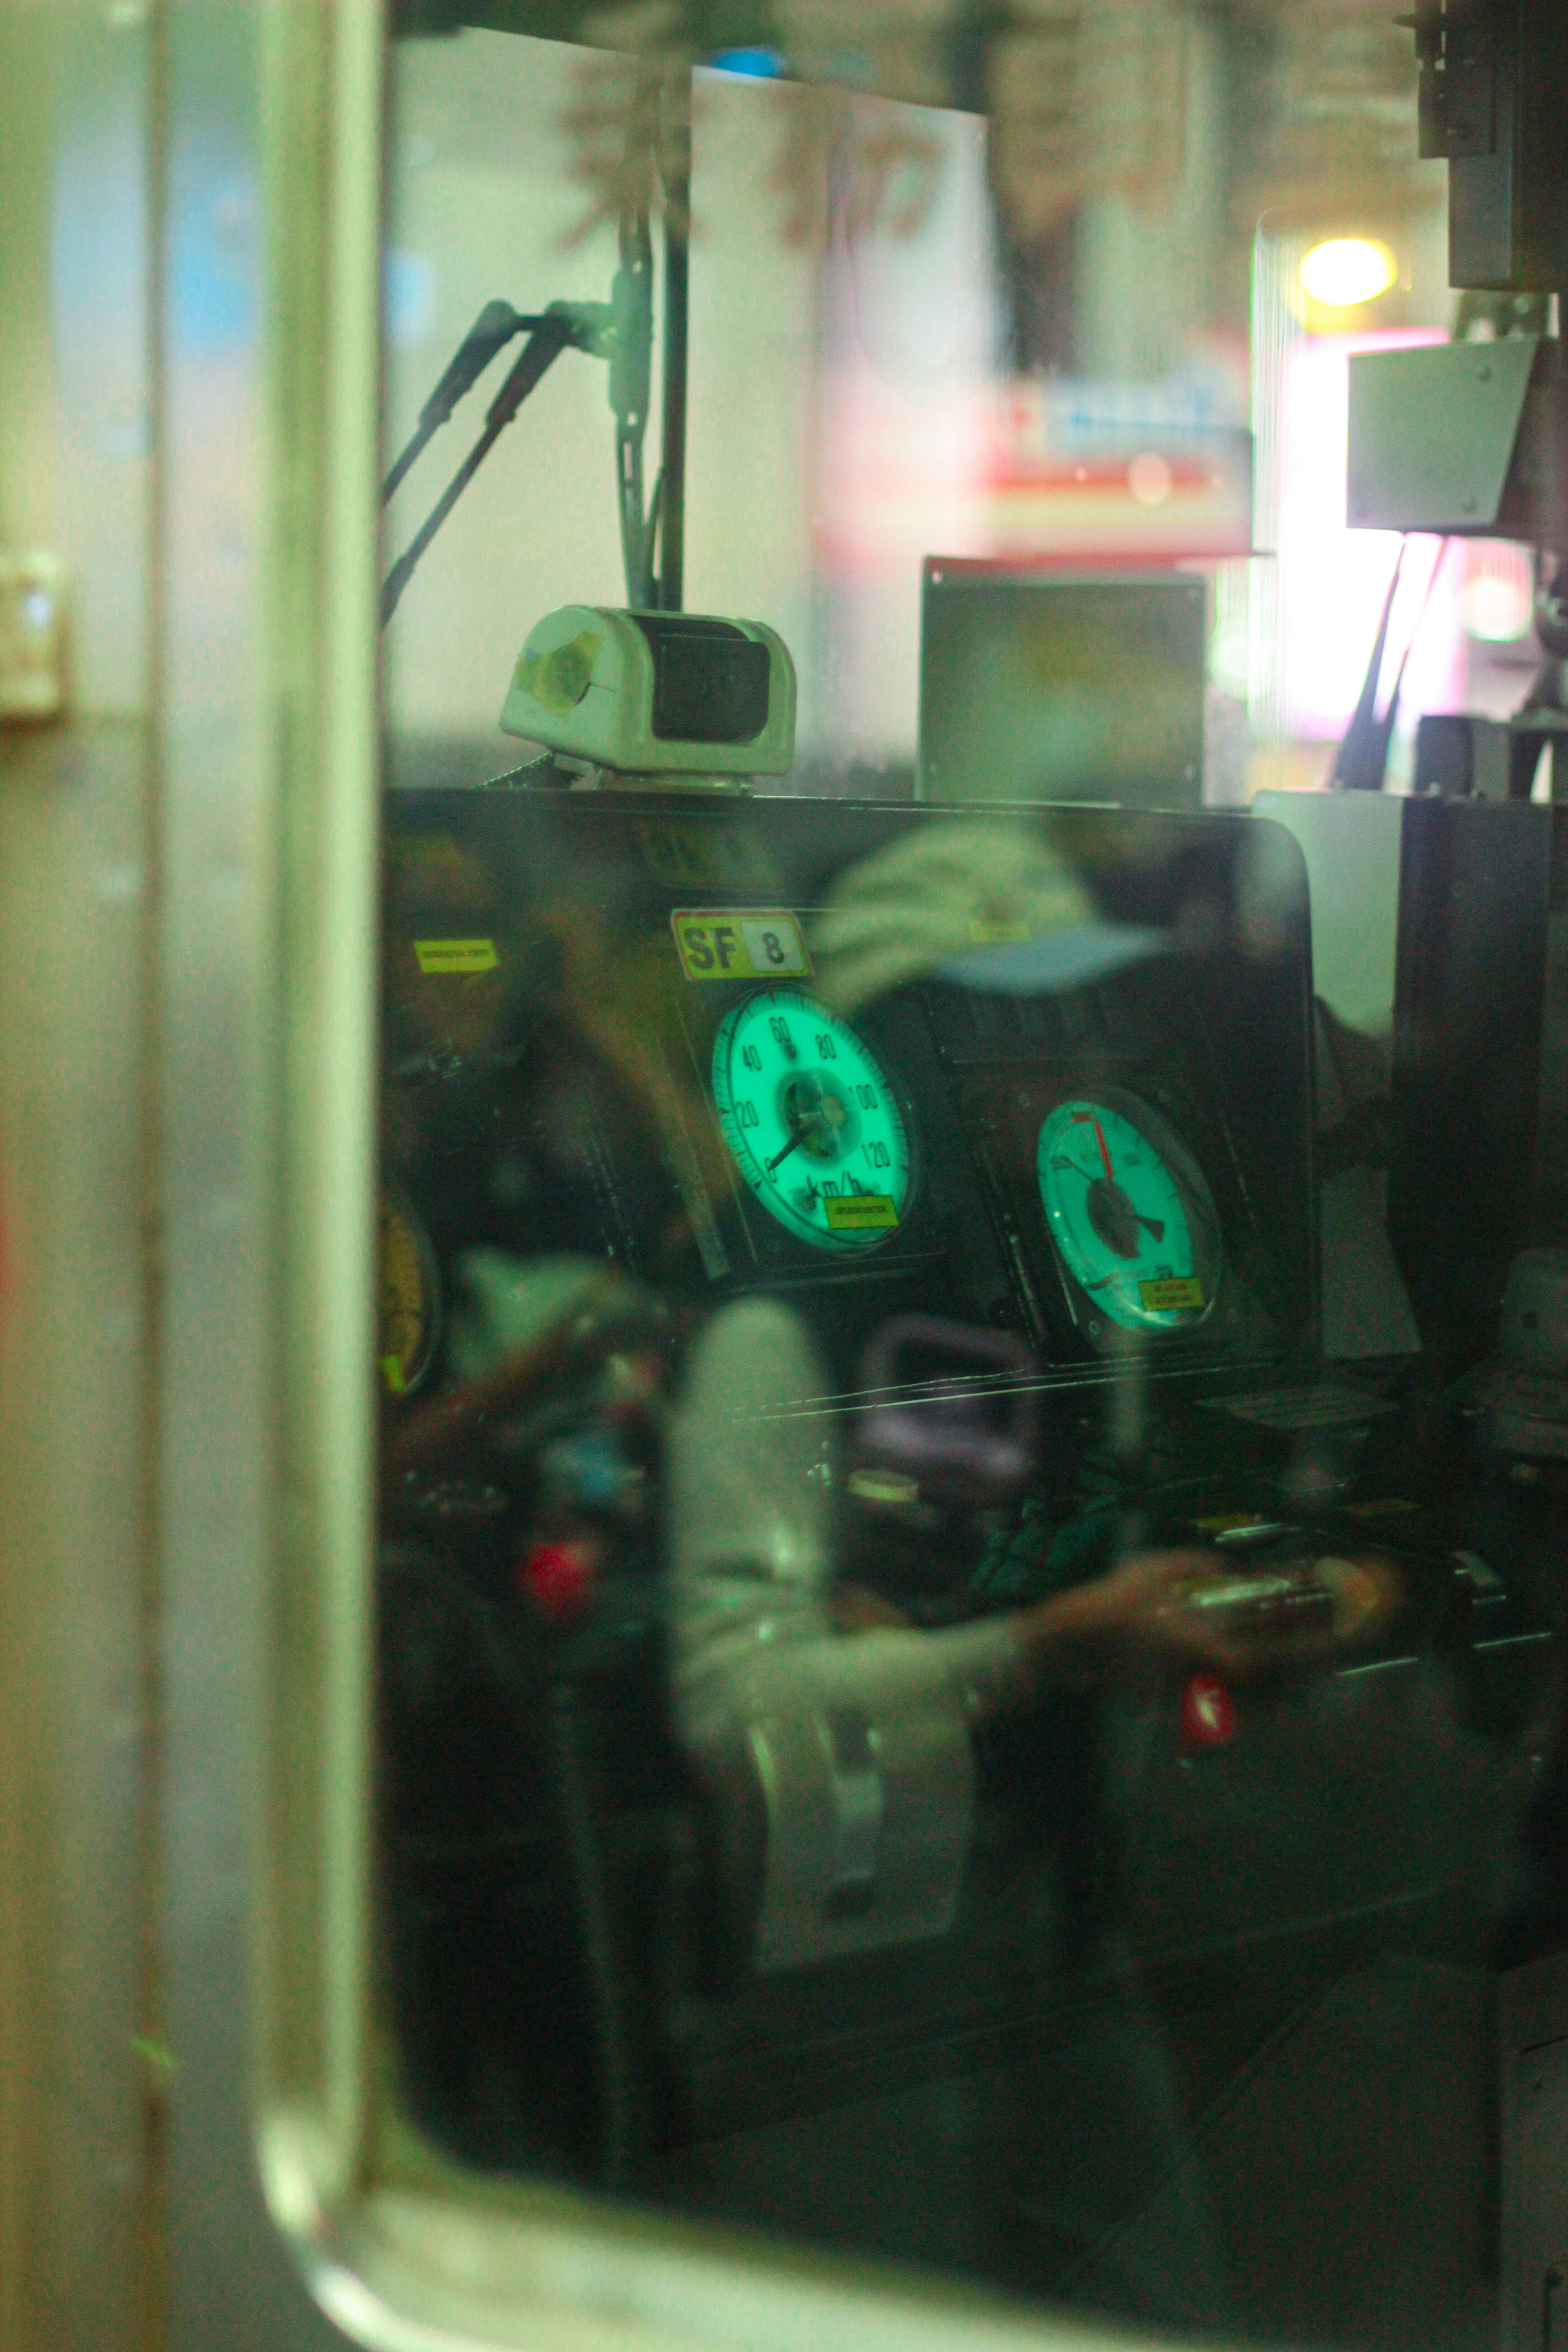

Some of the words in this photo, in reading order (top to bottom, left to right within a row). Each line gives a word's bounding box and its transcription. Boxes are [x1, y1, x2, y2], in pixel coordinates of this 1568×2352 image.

[684, 927, 735, 970] SF
[762, 932, 785, 964] 8
[769, 1016, 791, 1043] 60
[742, 1045, 762, 1071] 40
[814, 1034, 837, 1060] 80
[848, 1083, 878, 1110] 100
[736, 1101, 759, 1127] 20
[861, 1141, 891, 1169] 120
[806, 1169, 863, 1198] km/h
